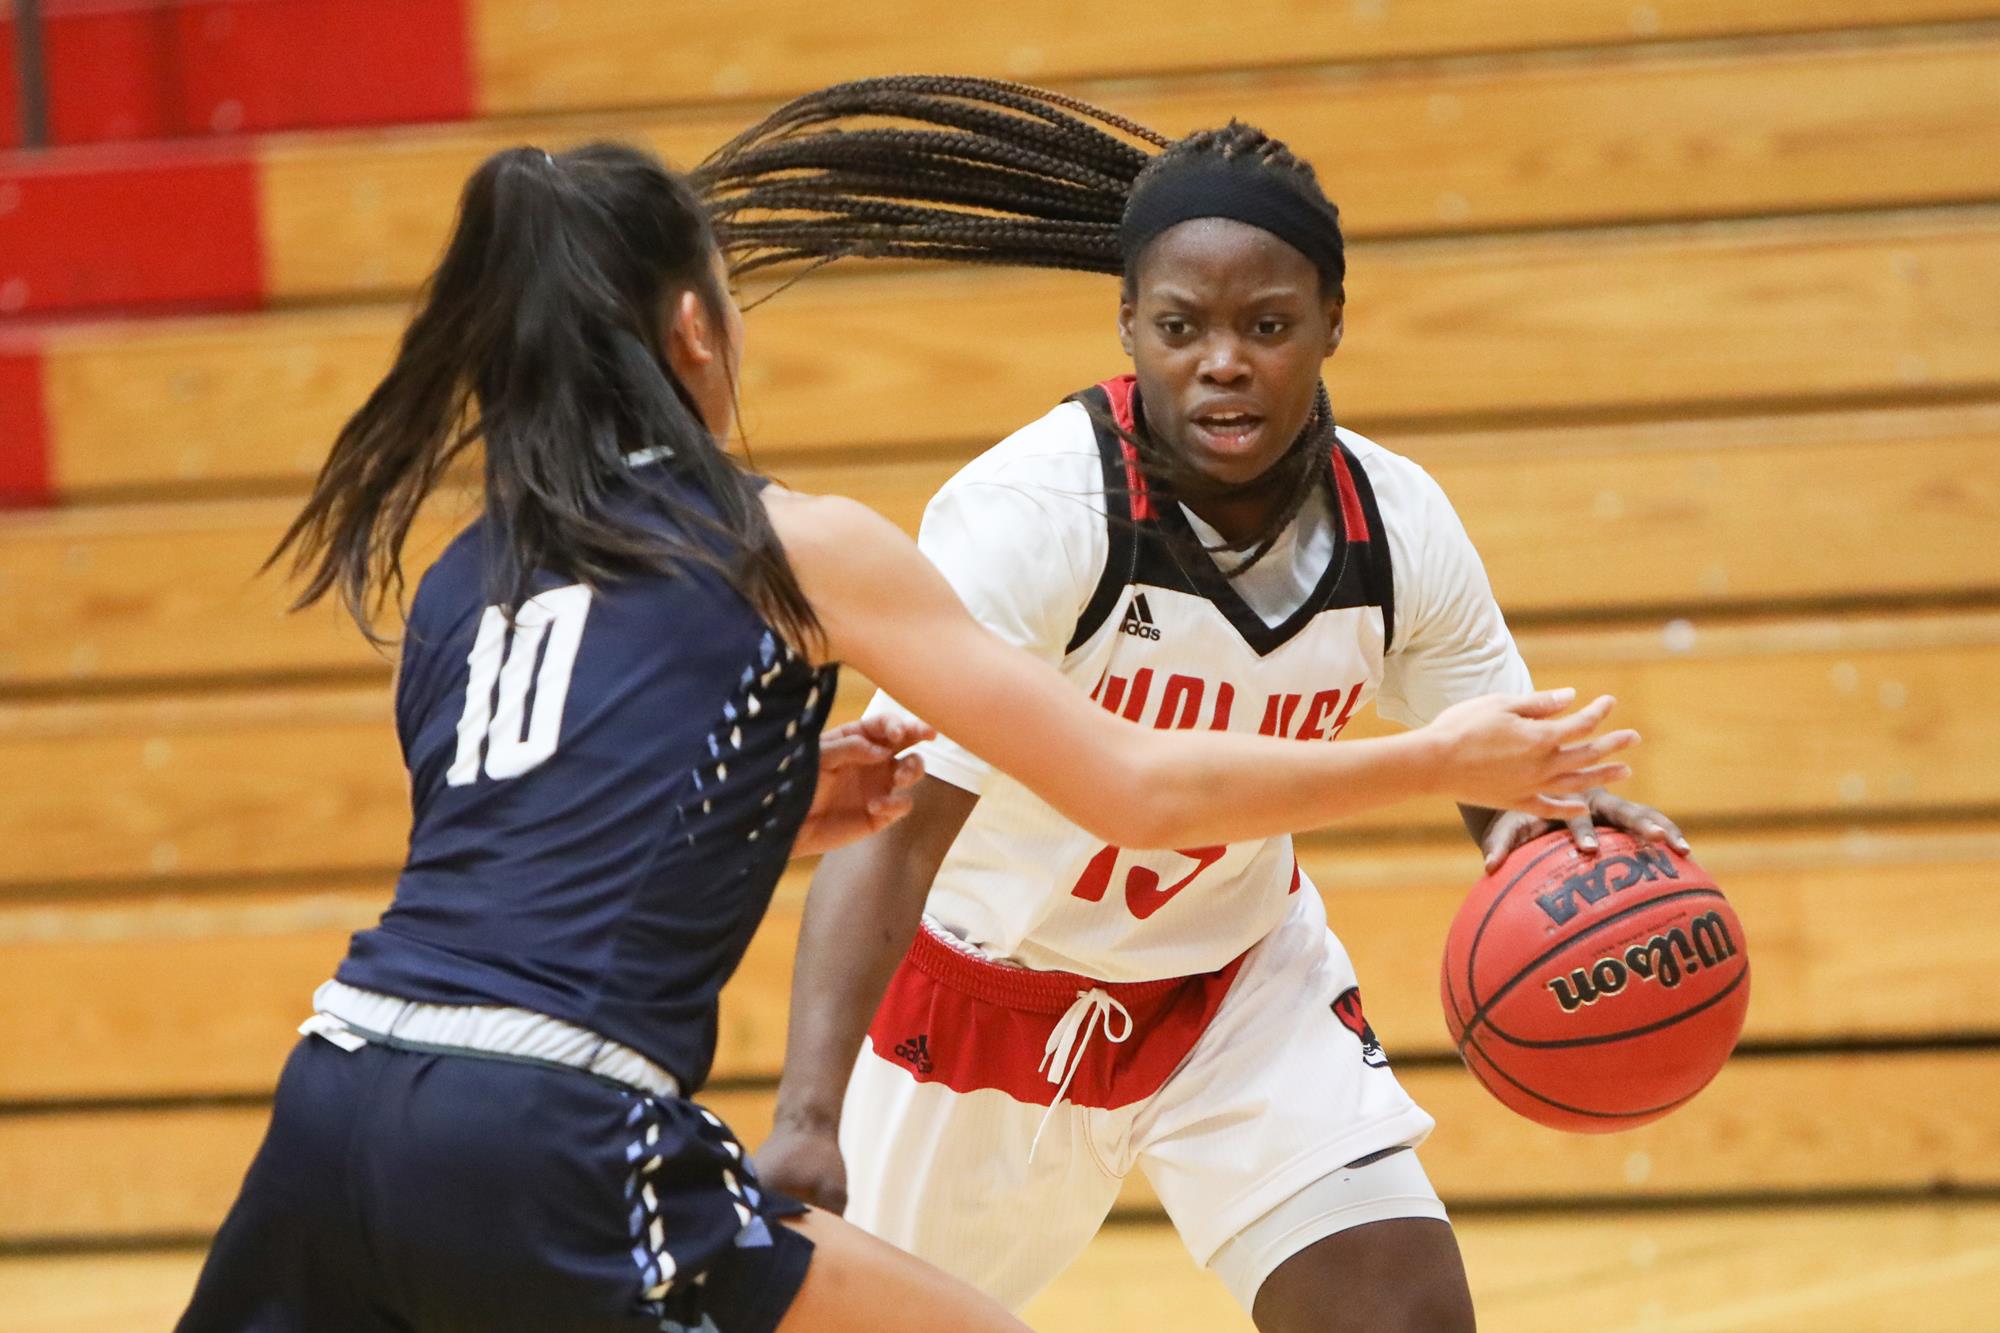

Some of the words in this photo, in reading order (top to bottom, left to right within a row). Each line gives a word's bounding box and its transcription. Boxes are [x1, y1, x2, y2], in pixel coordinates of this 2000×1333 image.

[1119, 618, 1161, 641] idas
[446, 583, 592, 787] 10
[1535, 848, 1680, 926] NCAA
[1548, 910, 1739, 1014] Wilson
